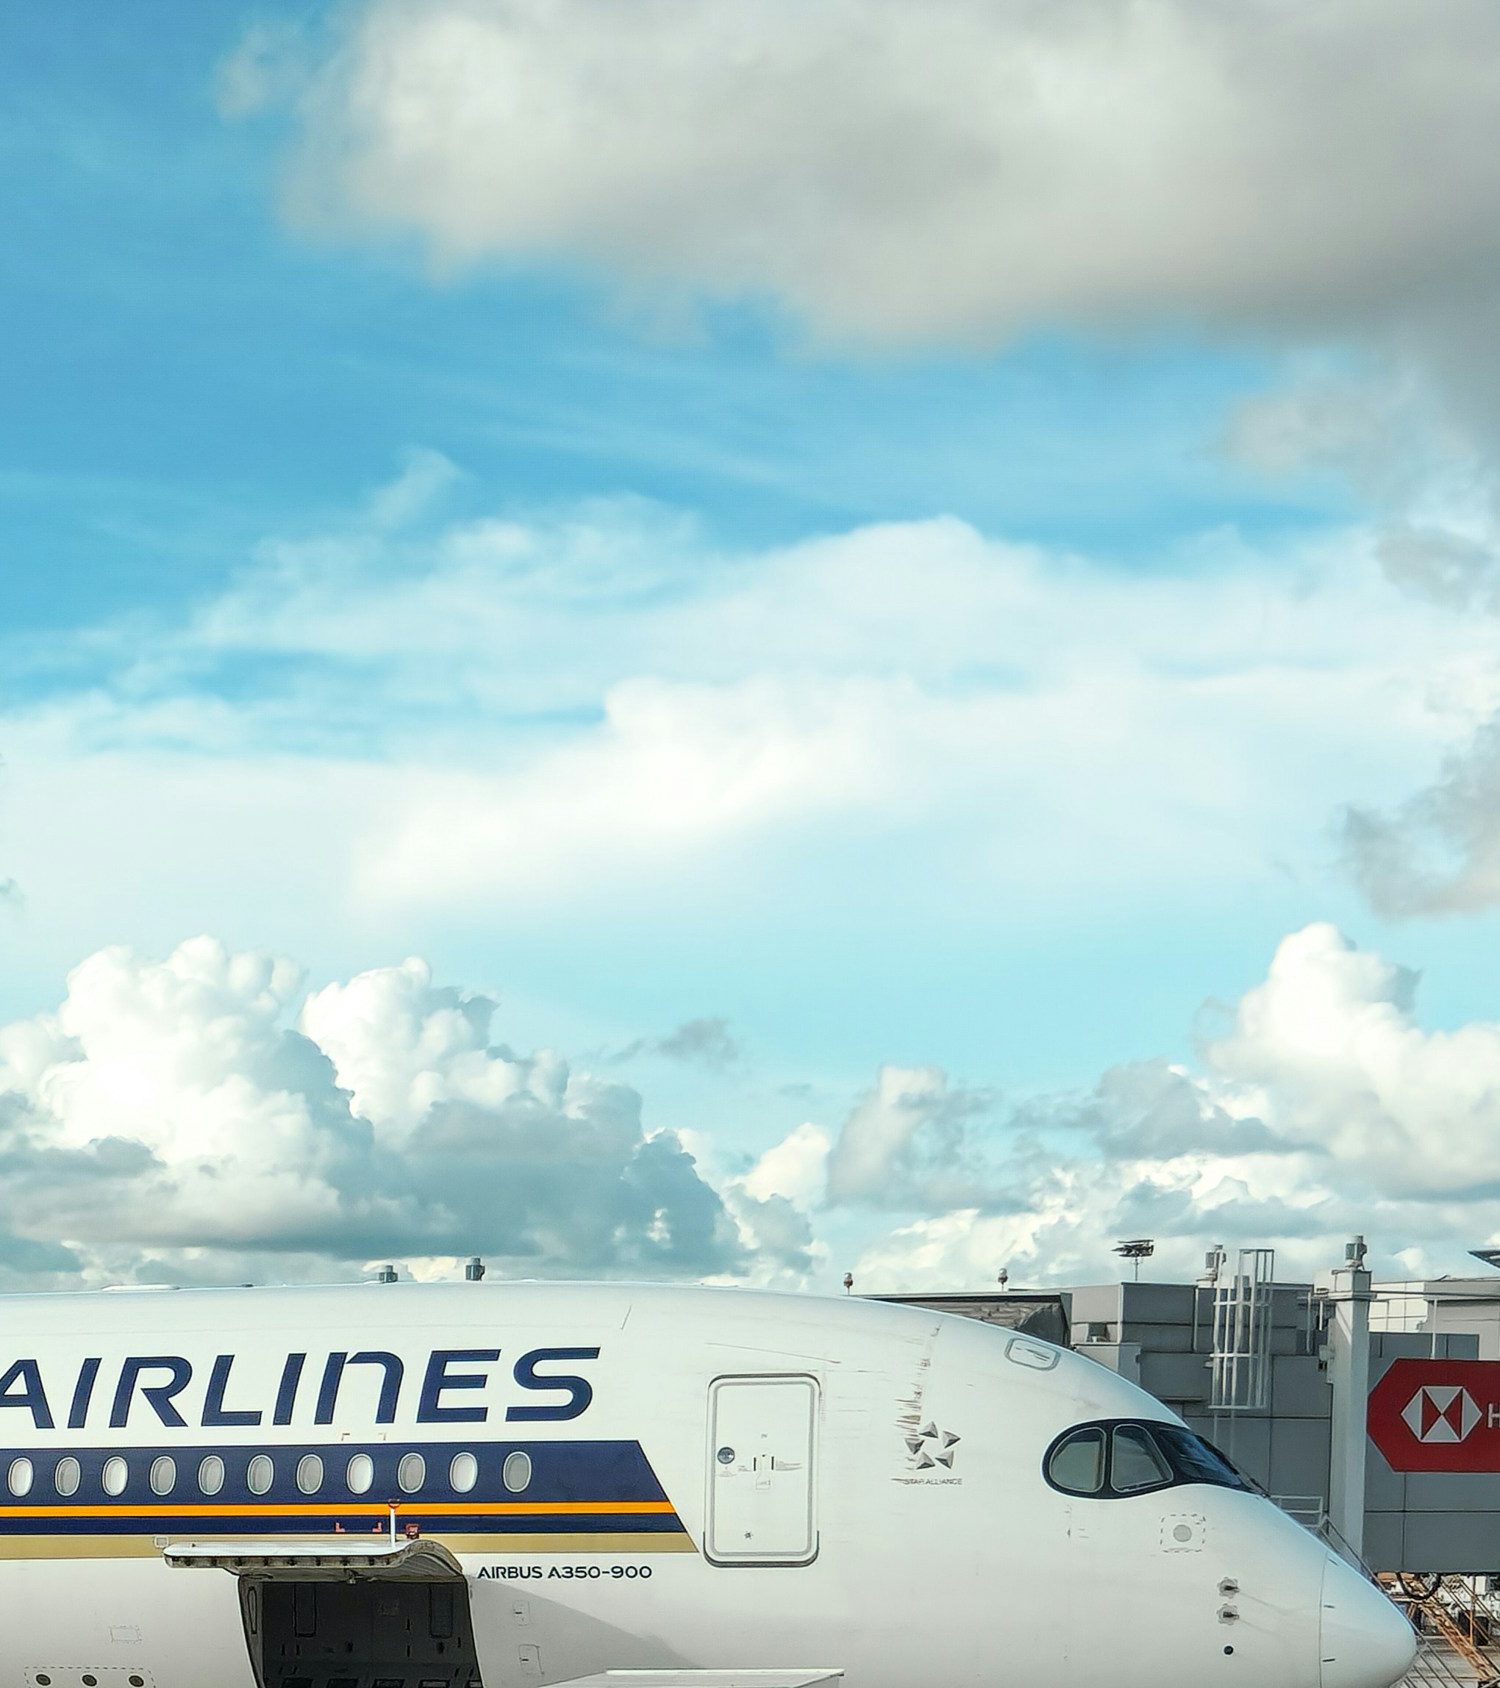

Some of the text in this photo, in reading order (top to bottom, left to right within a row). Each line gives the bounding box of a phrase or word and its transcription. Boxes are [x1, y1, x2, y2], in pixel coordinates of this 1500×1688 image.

[925, 1478, 963, 1486] ALLIANCE
[477, 1565, 653, 1580] AIRBUS A350-900
